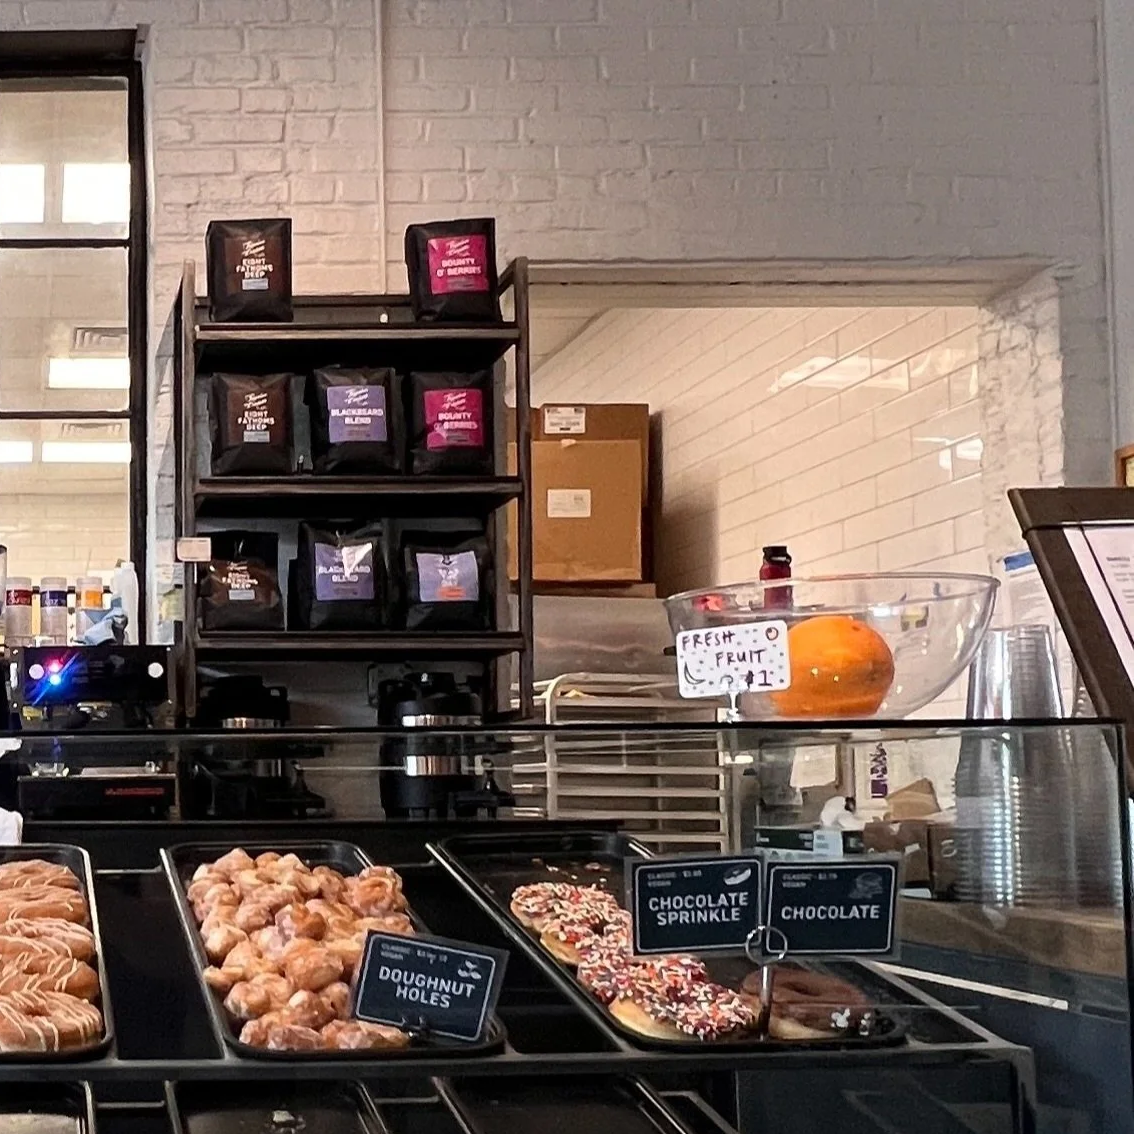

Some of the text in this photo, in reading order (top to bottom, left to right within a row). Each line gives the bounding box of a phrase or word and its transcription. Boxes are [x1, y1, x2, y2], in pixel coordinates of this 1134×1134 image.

[331, 408, 384, 417] BLACKBEARD
[344, 416, 372, 425] BLEND
[682, 630, 736, 651] FRESH
[715, 649, 767, 668] FRUIT
[648, 891, 749, 911] CHOCOLATE
[656, 907, 741, 926] SPRINKLE
[781, 904, 881, 920] CHOCOLATE
[378, 966, 476, 998] DOUGHNUT
[396, 985, 452, 1009] HOLES
